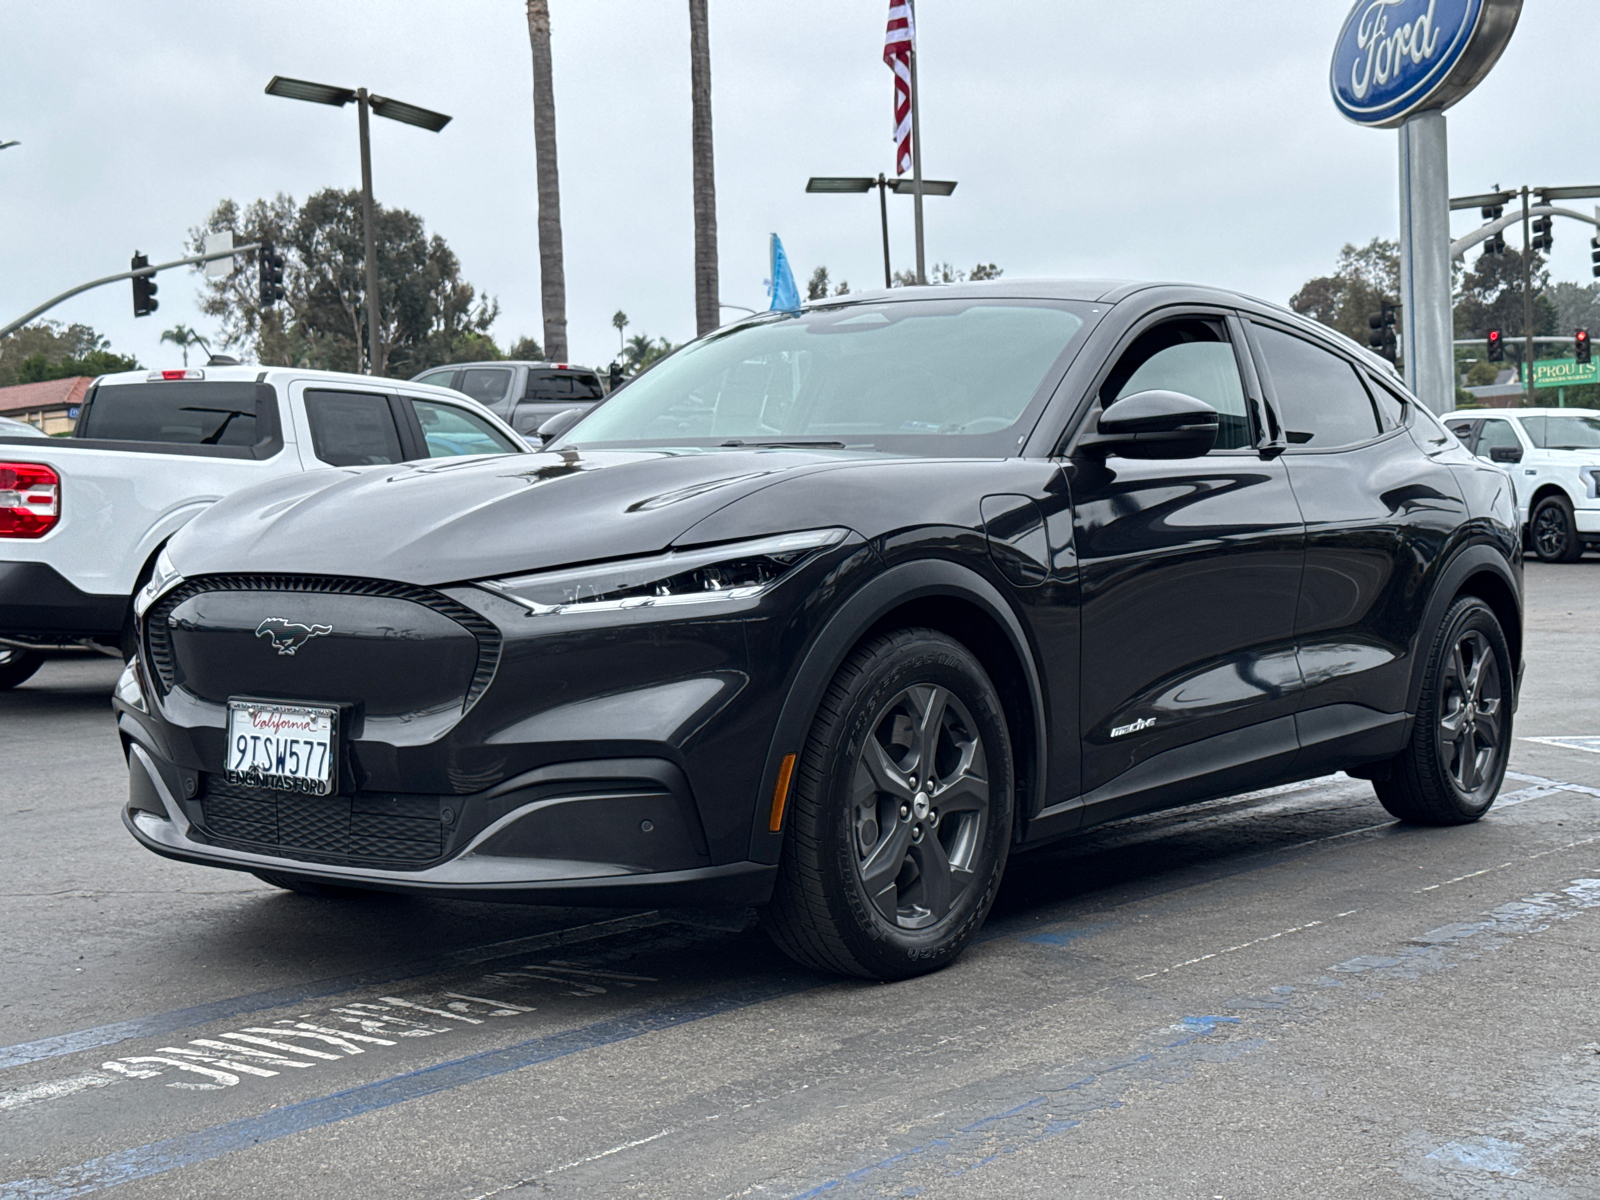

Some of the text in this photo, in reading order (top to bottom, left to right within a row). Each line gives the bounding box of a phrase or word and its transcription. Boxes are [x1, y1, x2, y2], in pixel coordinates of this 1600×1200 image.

[1352, 0, 1439, 98] Ford
[252, 711, 317, 735] California
[234, 734, 328, 778] 9TSW577
[227, 769, 327, 796] ENCINITAS FORD
